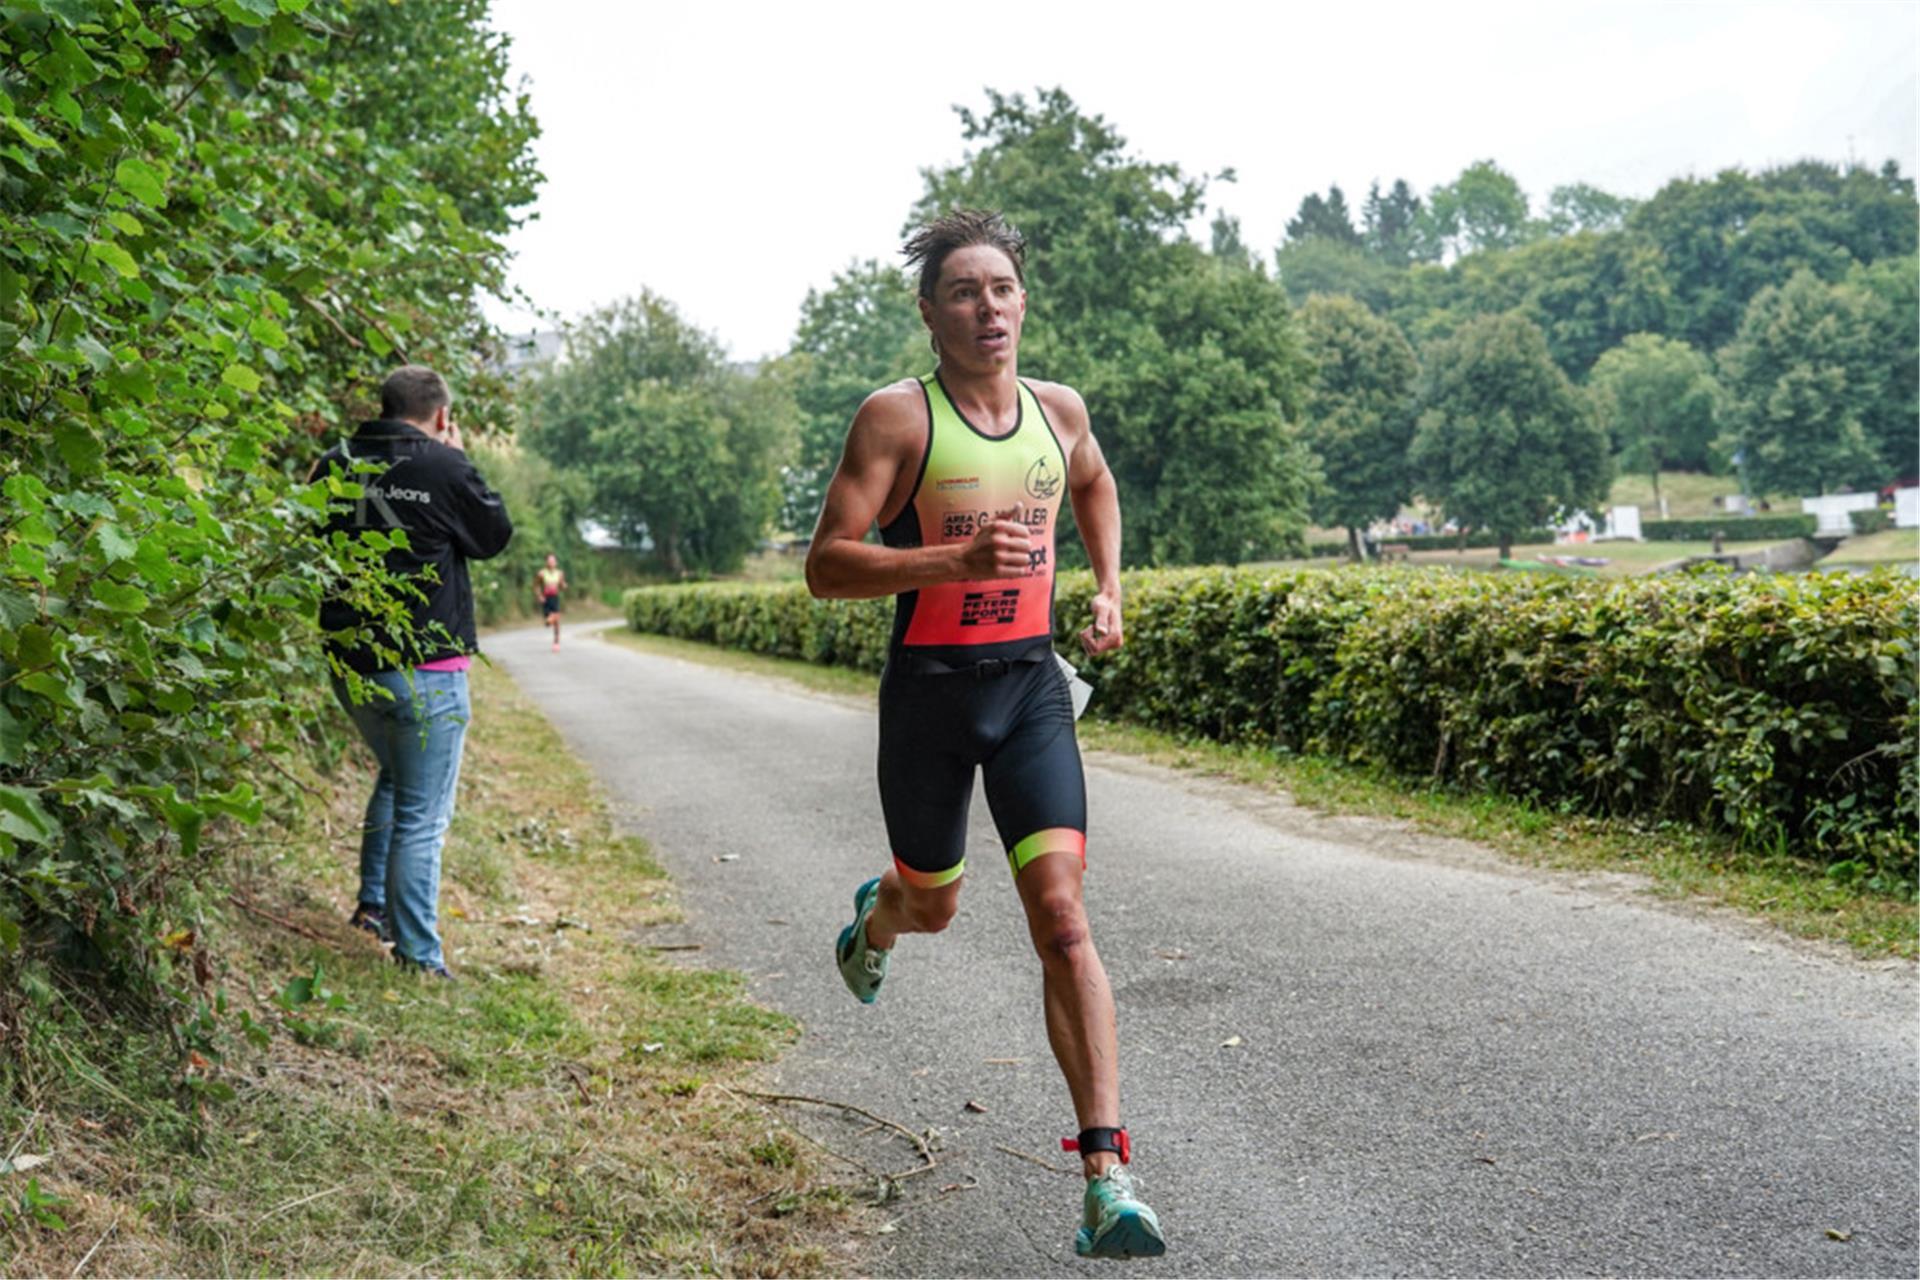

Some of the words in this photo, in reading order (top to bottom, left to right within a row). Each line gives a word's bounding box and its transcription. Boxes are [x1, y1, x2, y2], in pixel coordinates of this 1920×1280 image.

[386, 485, 430, 503] Jeans
[945, 514, 974, 524] AREA
[945, 525, 972, 536] 352
[963, 598, 1017, 609] PETERS
[961, 606, 1016, 618] SPORTS
